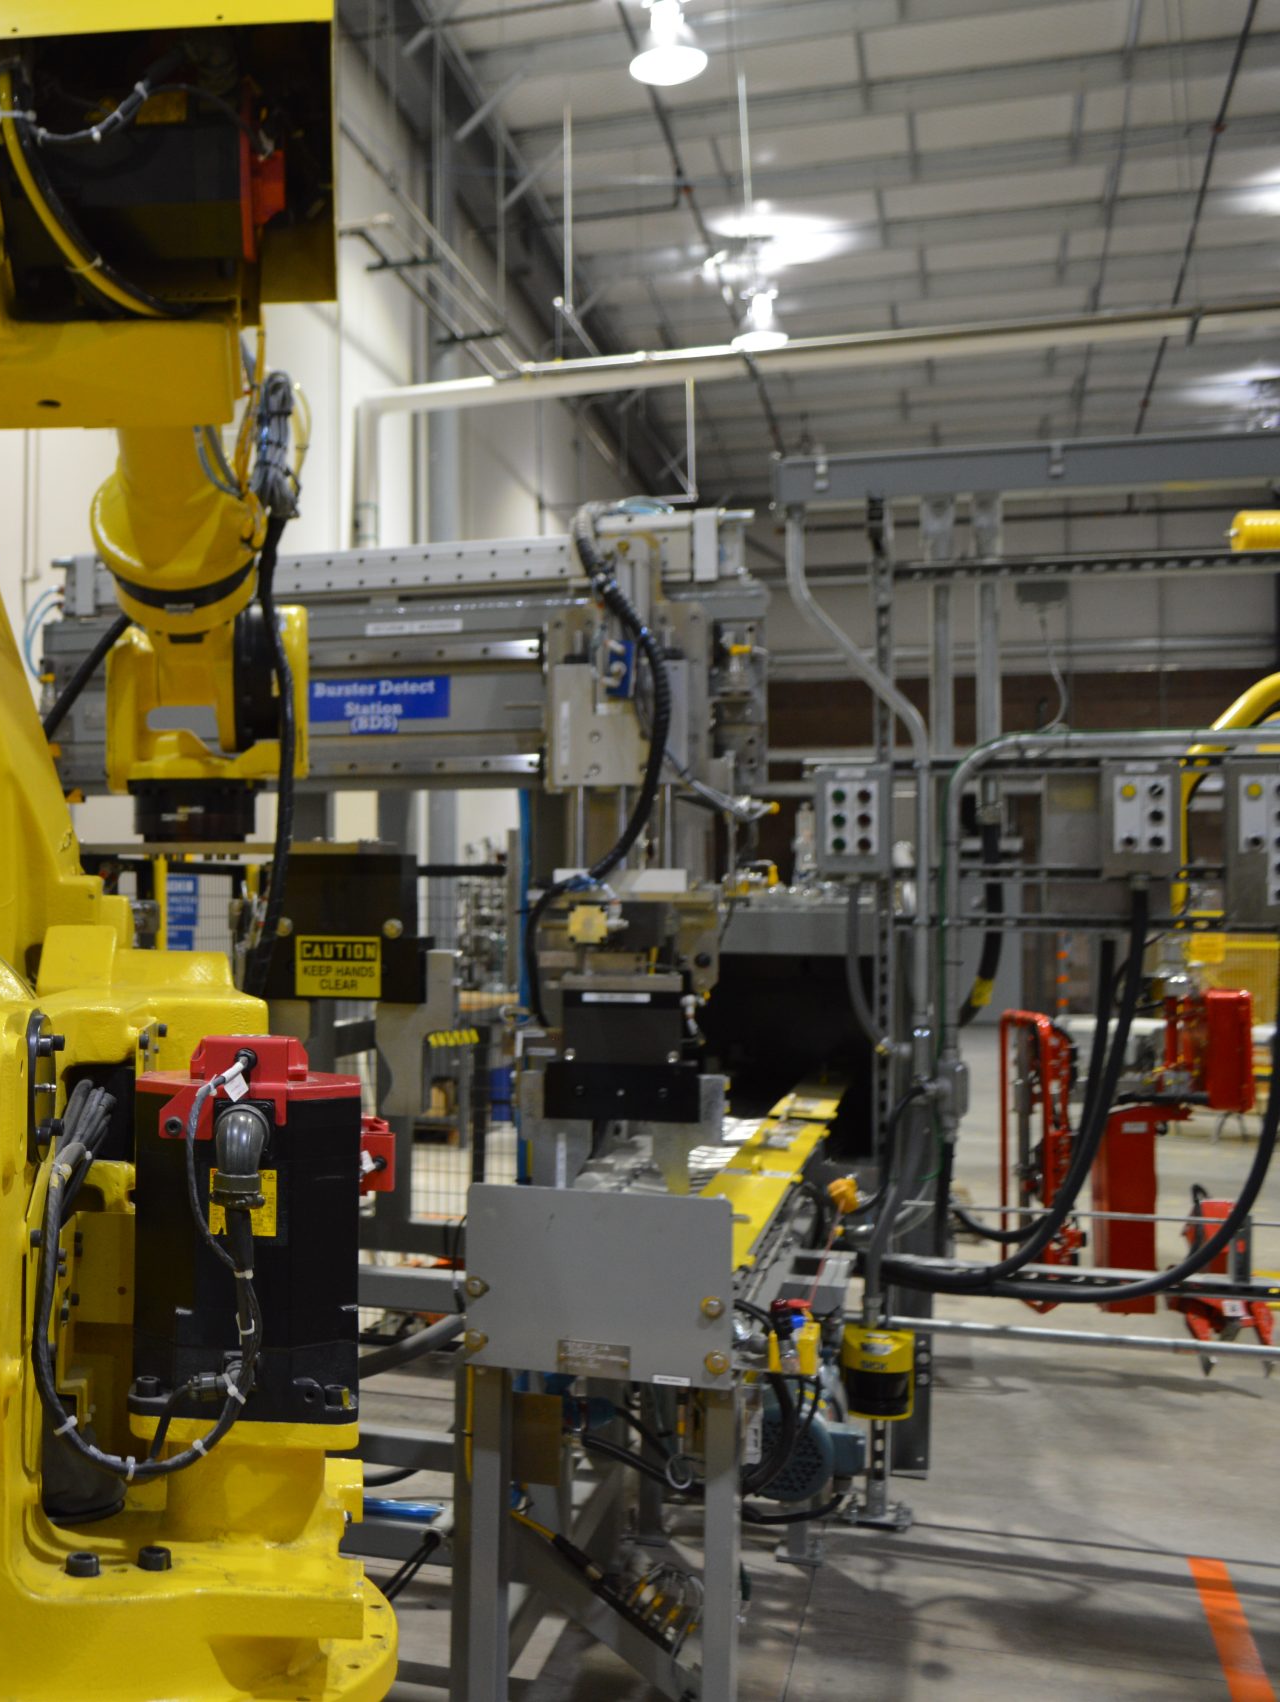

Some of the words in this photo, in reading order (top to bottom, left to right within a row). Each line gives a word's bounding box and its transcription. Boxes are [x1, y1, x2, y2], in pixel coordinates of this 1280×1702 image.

[313, 682, 376, 698] Burster
[378, 680, 435, 696] Detect
[344, 701, 403, 717] Station
[350, 715, 400, 734] (BDS)
[302, 943, 376, 959] CAUTION
[302, 965, 333, 976] KEEP
[336, 966, 375, 978] HANDS
[320, 979, 358, 990] CLEAR
